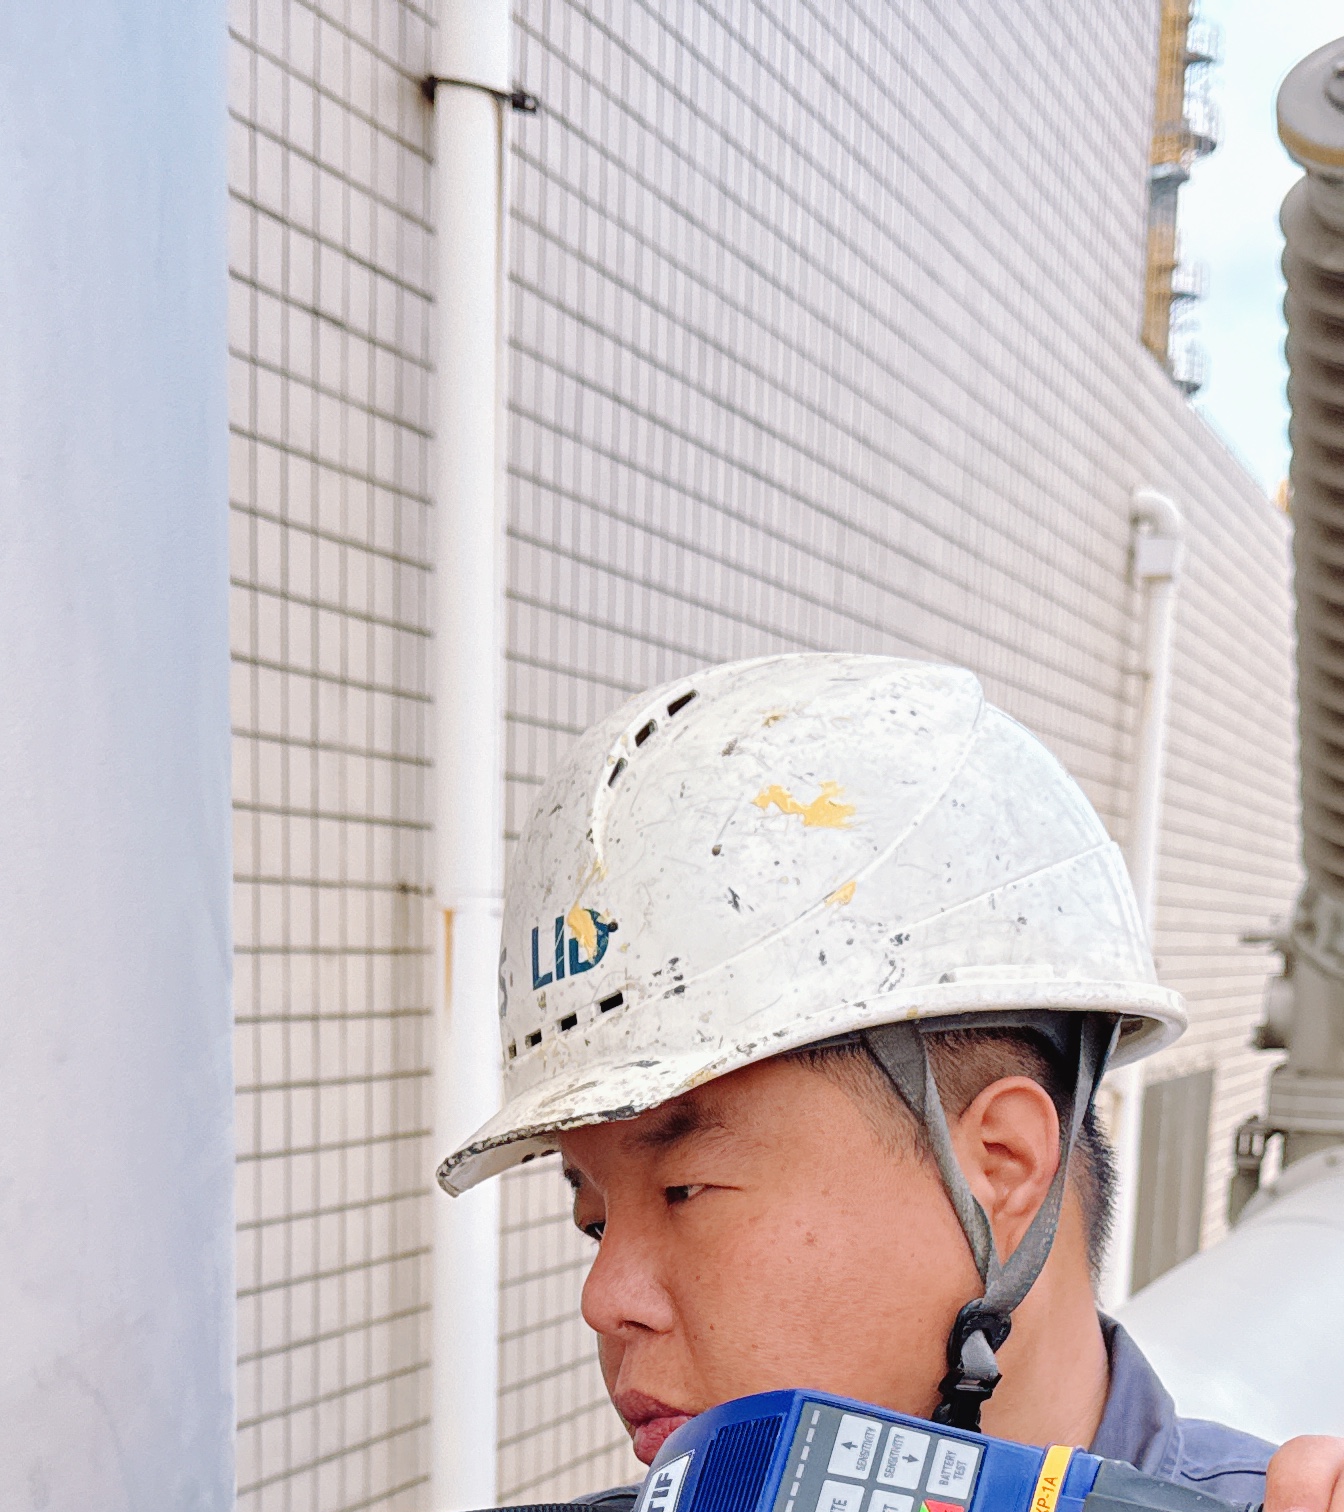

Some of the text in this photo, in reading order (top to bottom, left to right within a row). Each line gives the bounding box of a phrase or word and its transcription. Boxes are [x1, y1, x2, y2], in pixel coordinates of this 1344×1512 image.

[856, 1426, 877, 1472] SENSITIVITY
[883, 1433, 906, 1479] SENSITIVITY
[938, 1450, 956, 1487] BATTERY
[953, 1460, 967, 1481] TEST
